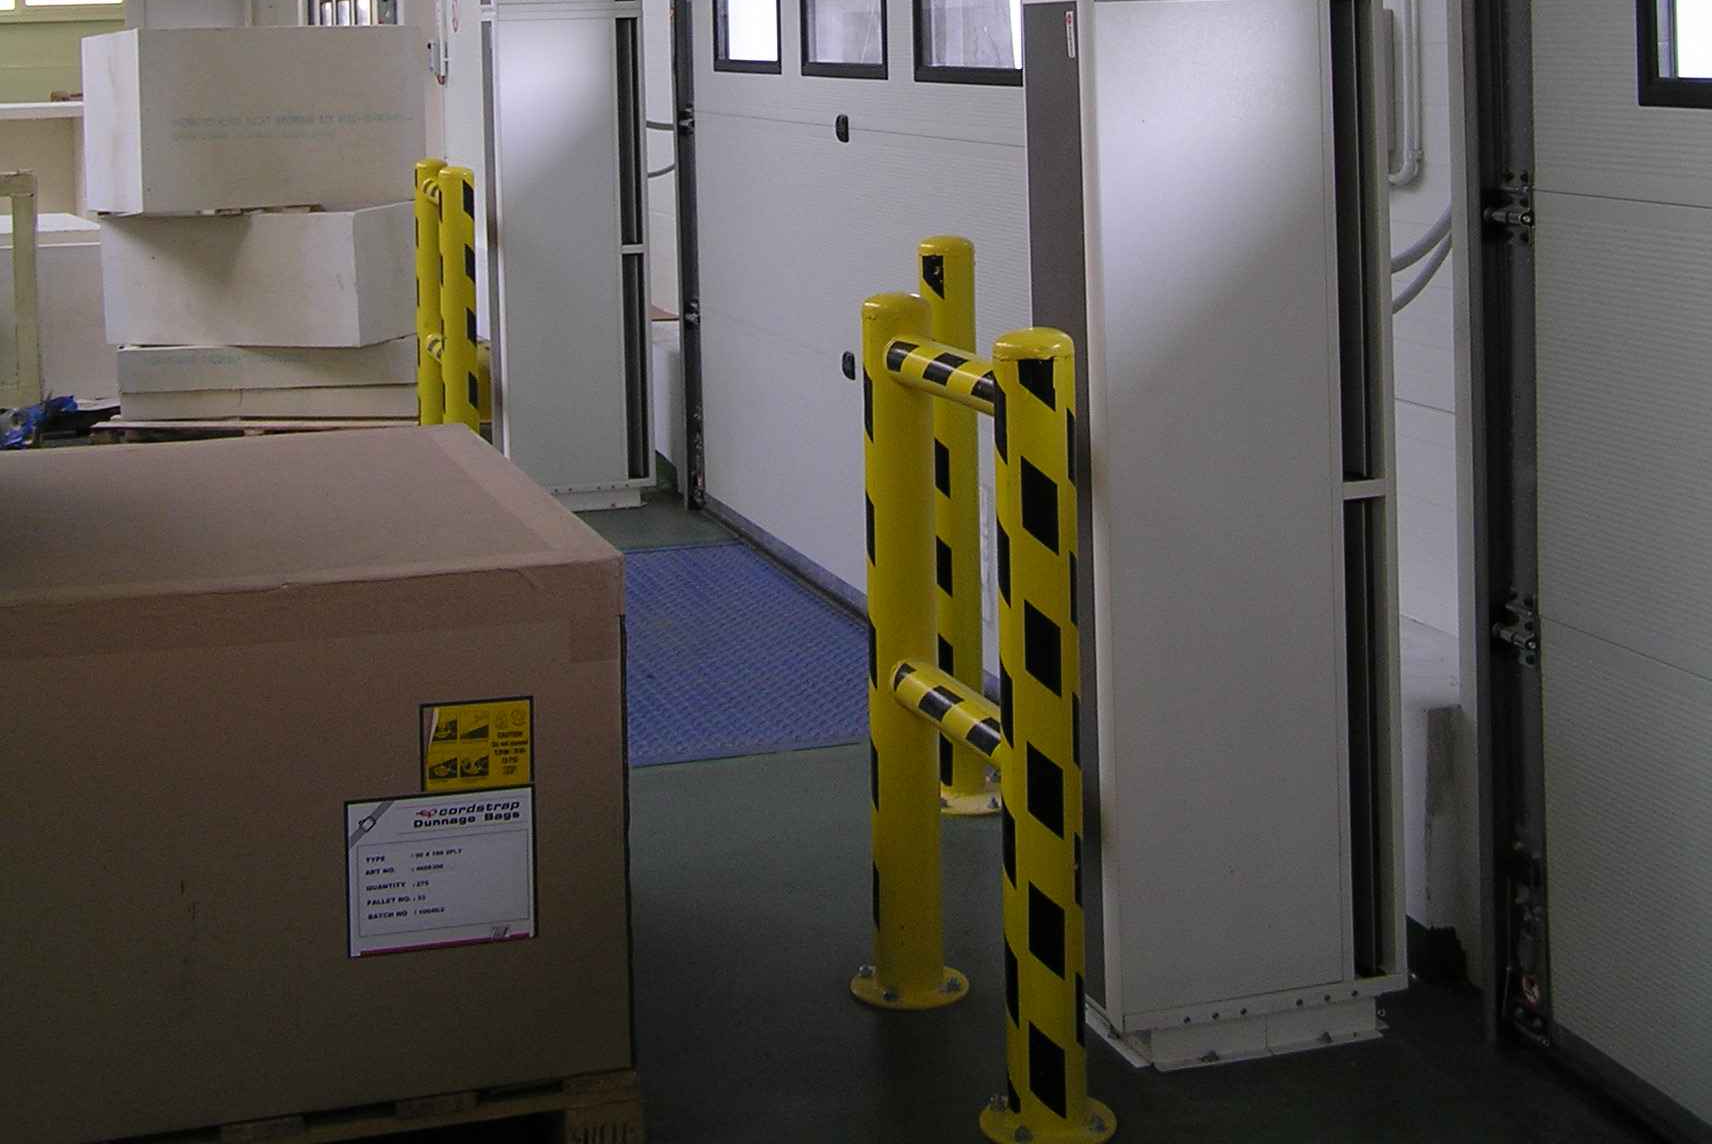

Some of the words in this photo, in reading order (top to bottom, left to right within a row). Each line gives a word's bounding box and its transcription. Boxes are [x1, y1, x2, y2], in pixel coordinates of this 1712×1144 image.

[439, 800, 520, 816] cordstrap
[413, 815, 476, 829] Dunnage
[484, 811, 520, 822] Bags
[366, 855, 385, 863] TYPE
[366, 882, 407, 891] QUANTITY
[367, 897, 396, 906] PALLET
[368, 911, 395, 920] BATCH
